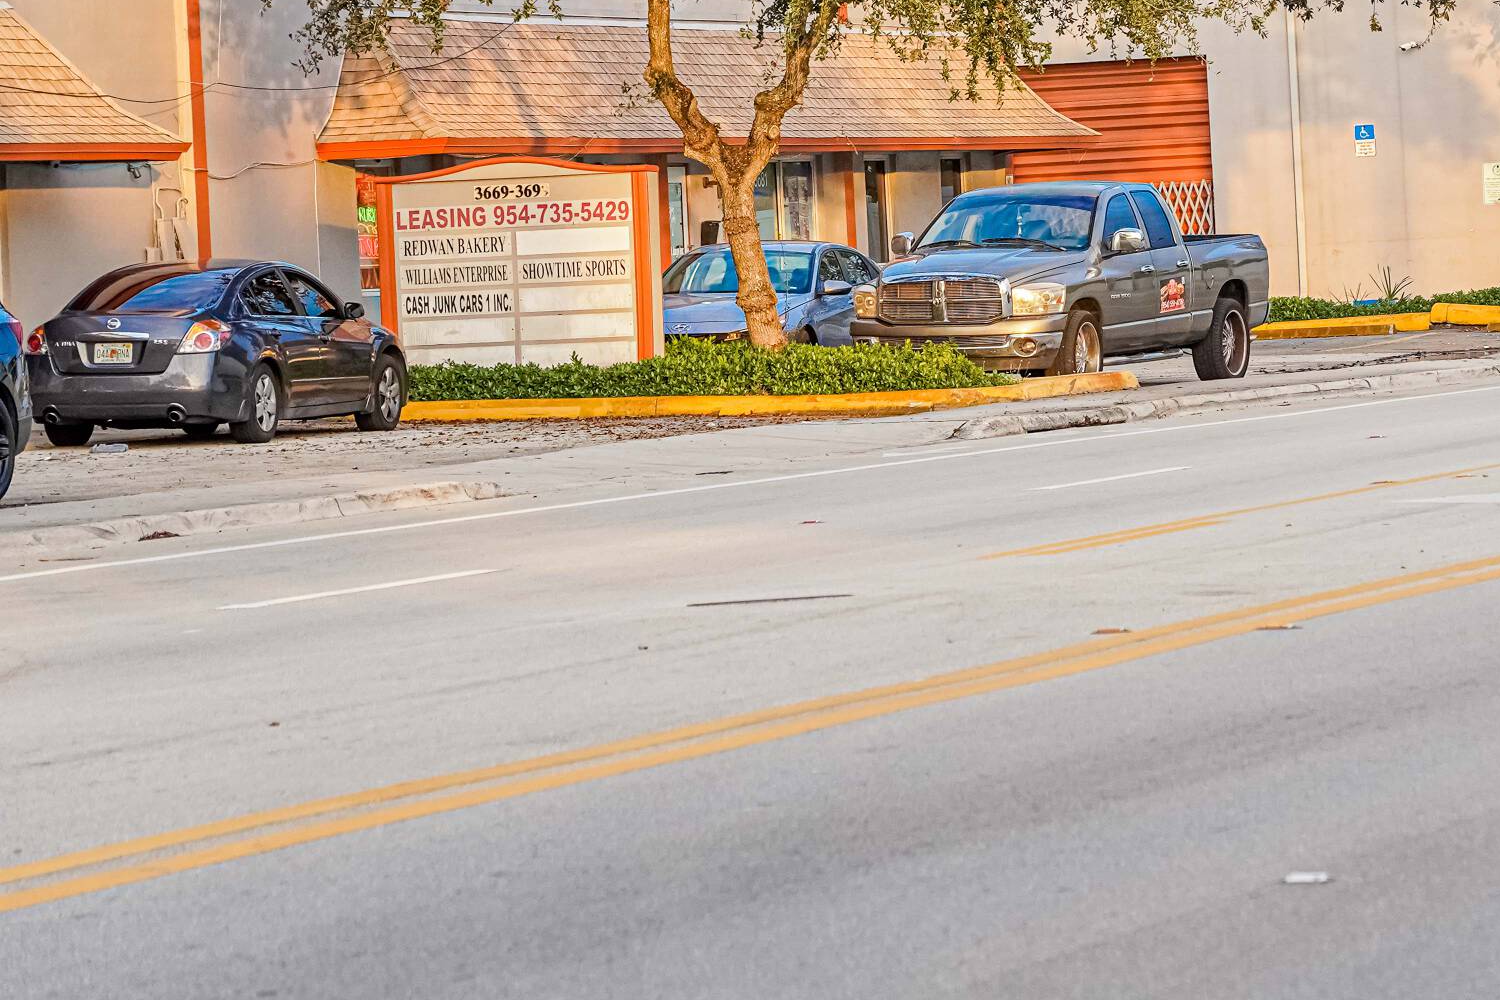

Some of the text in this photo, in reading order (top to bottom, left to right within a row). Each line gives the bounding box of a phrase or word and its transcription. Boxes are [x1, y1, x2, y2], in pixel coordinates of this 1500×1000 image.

[474, 183, 548, 200] 3669-369
[396, 200, 630, 231] LEASING 954-735-5429
[404, 236, 506, 257] REDWAN BAKERY
[405, 265, 508, 285] WILLIAMS ENTERPRISE
[522, 259, 626, 280] SHOWTIME SPORTS
[405, 293, 512, 314] CASH JUNK CARS 1 INC.
